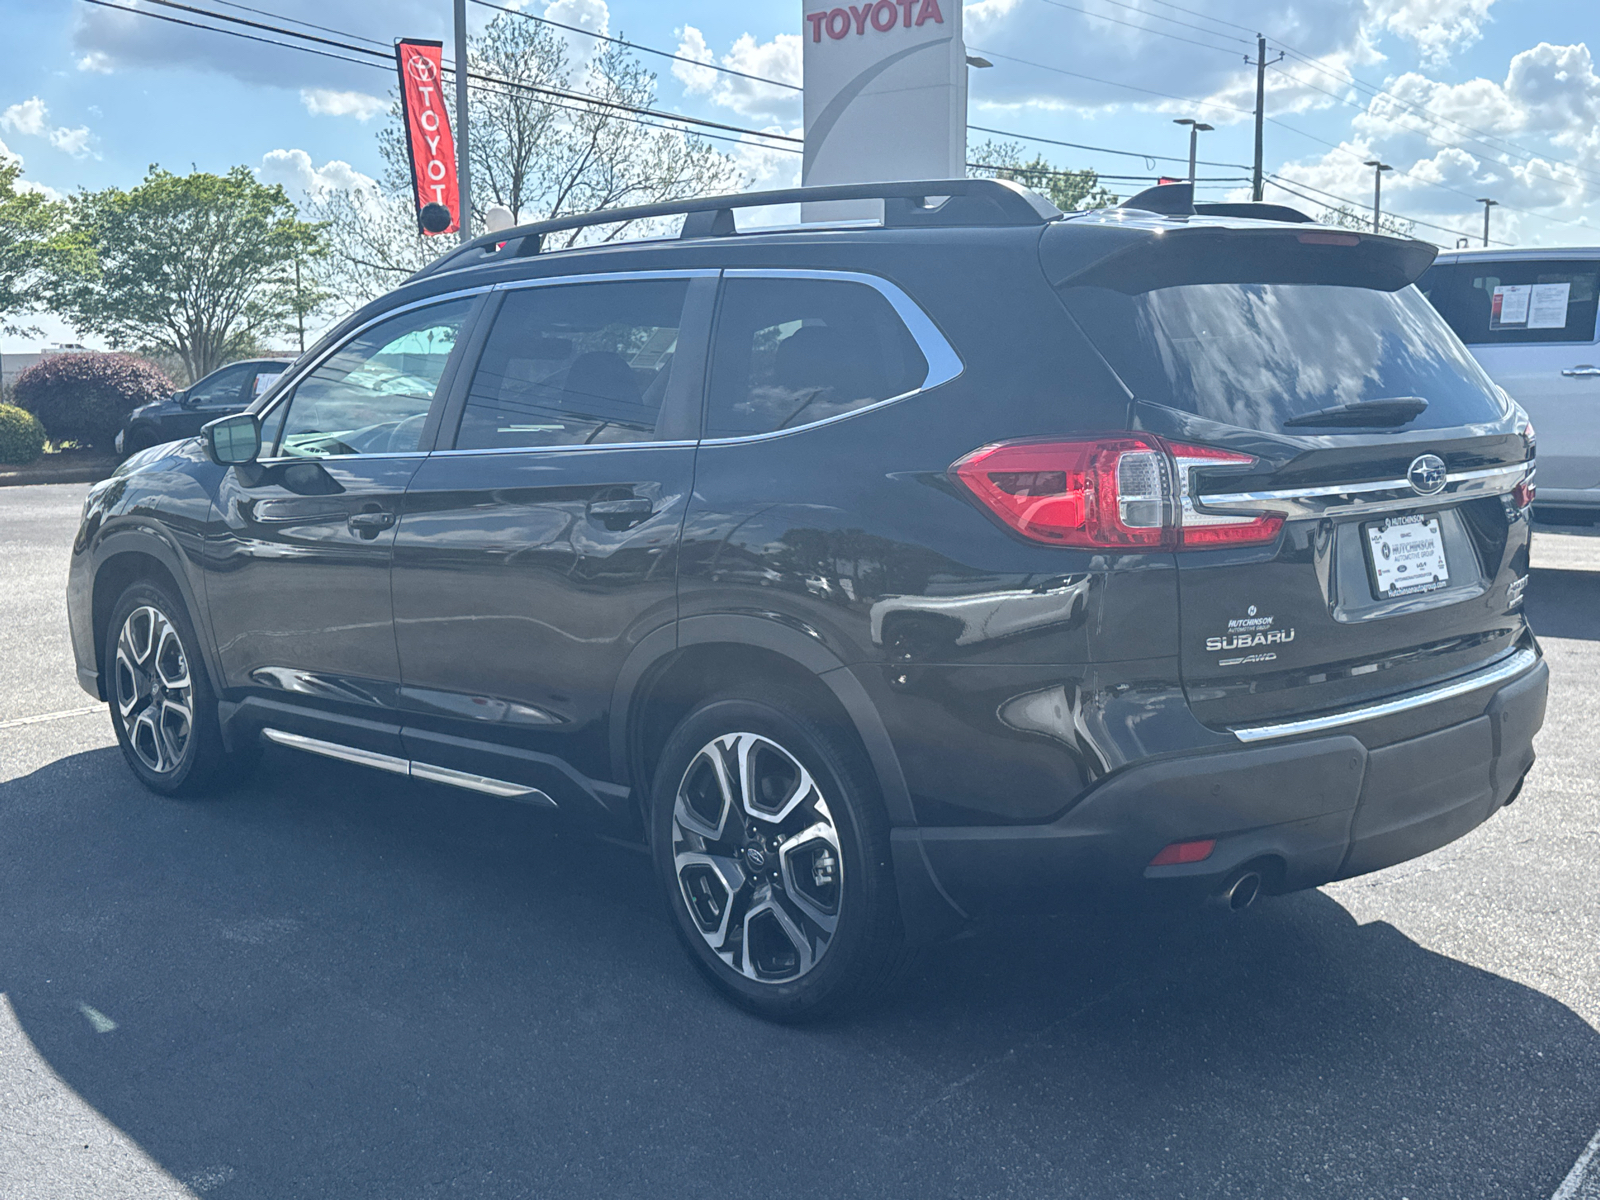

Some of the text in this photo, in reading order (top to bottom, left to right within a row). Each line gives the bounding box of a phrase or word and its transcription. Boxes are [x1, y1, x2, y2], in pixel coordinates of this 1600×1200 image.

[806, 0, 944, 43] TOYOTA
[418, 86, 452, 224] TOYOT
[1392, 515, 1424, 526] HUTCHINSON
[1392, 541, 1435, 555] HUTCHINSON
[1395, 550, 1434, 562] AUTOMOTIVE GROUP
[1228, 616, 1274, 628] HUTCHINSON
[1206, 628, 1295, 651] SUBARU
[1242, 652, 1277, 663] AWD
